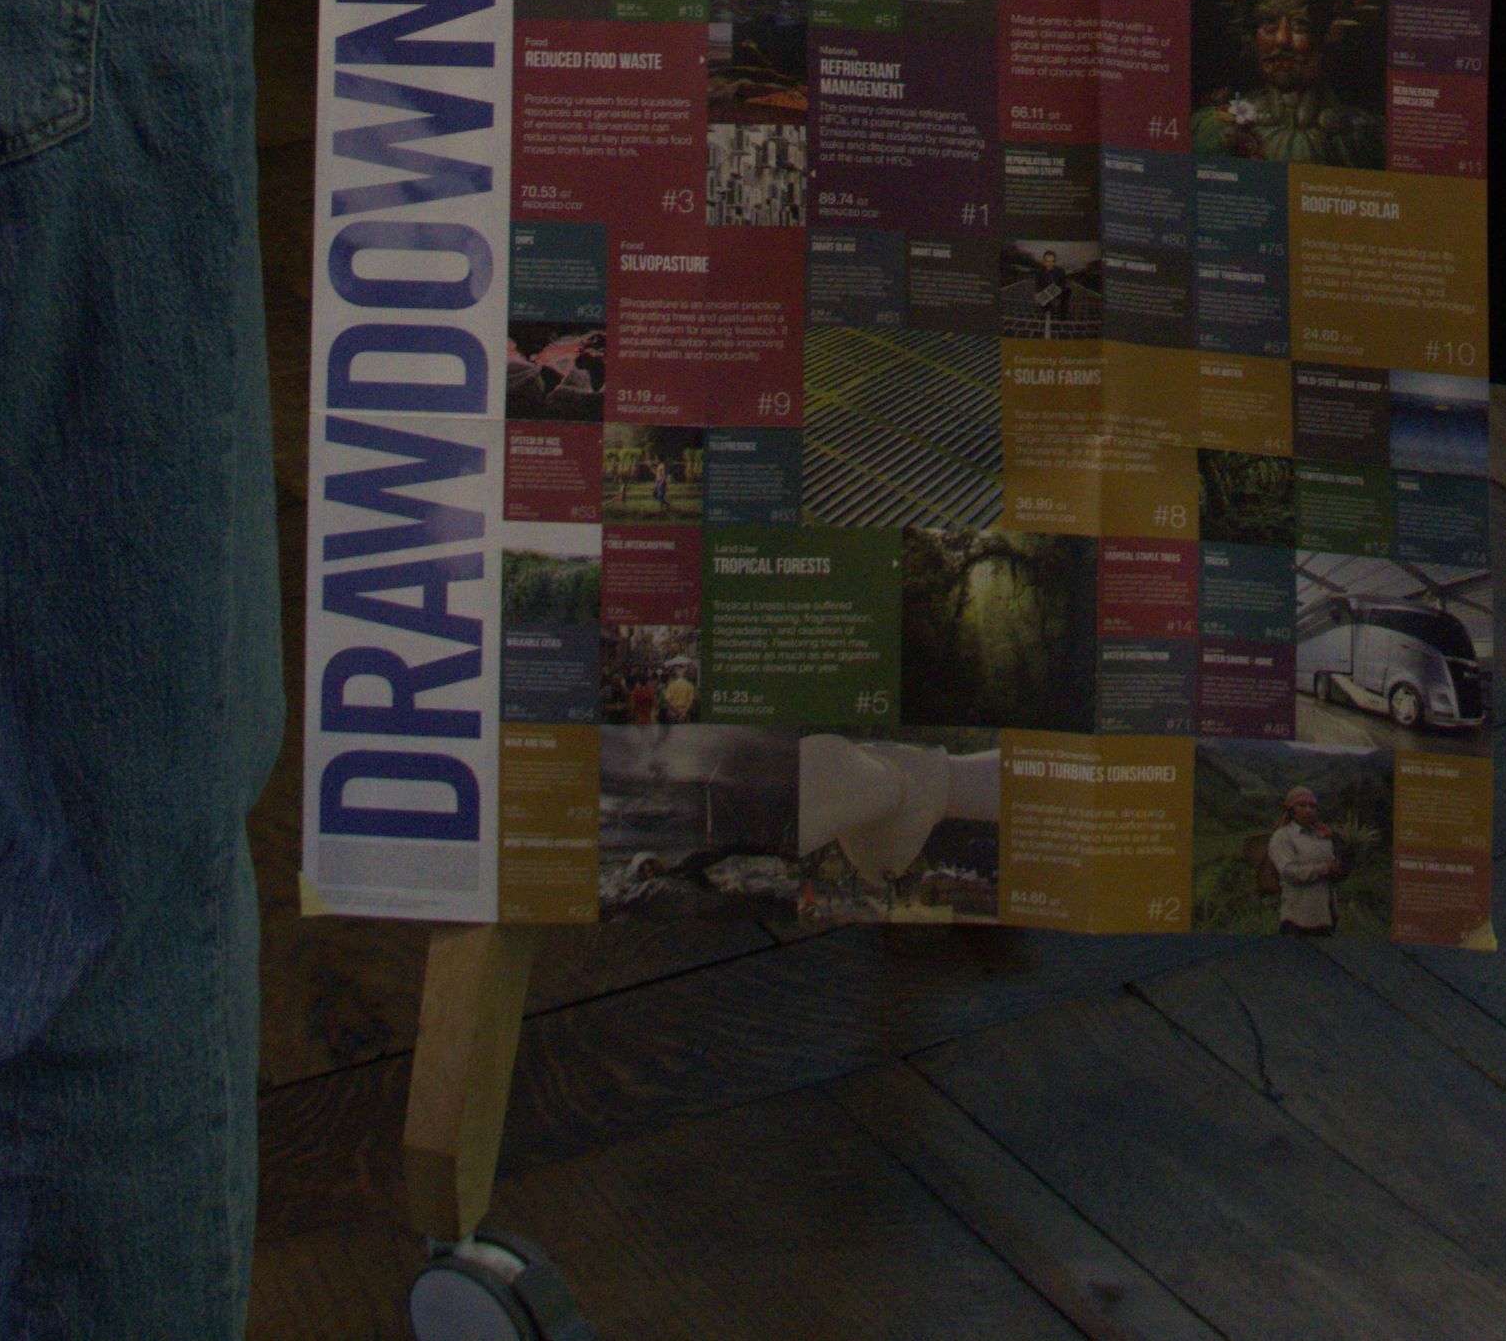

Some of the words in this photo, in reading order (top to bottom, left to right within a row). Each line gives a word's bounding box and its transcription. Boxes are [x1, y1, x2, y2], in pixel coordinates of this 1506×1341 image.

[525, 51, 582, 69] REDUCED
[584, 52, 616, 70] FOOD
[619, 53, 663, 71] WASTE
[820, 59, 902, 80] REFRIGERANT
[821, 78, 906, 100] MANAGEMENT
[1147, 115, 1180, 140] #4
[521, 185, 557, 199] 70.53
[661, 190, 695, 214] #3
[819, 192, 854, 206] 89.74
[961, 203, 990, 225] #1
[1302, 195, 1355, 217] ROOFTOP
[1359, 199, 1400, 220] SOLAR
[620, 255, 710, 274] SILVOPASTURE
[1425, 340, 1476, 366] #10
[1014, 369, 1055, 386] SOLAR
[1058, 369, 1102, 386] FARMS
[617, 390, 651, 403] 31.19
[758, 392, 791, 416] #9
[1154, 504, 1187, 529] #8
[713, 556, 773, 576] TROPICAL
[775, 556, 832, 575] FORESTS
[856, 691, 889, 714] #5
[1012, 761, 1045, 778] WIND
[1047, 763, 1104, 782] TURBINES
[1106, 766, 1176, 784] (ONSHORE)
[1148, 897, 1181, 922] #2
